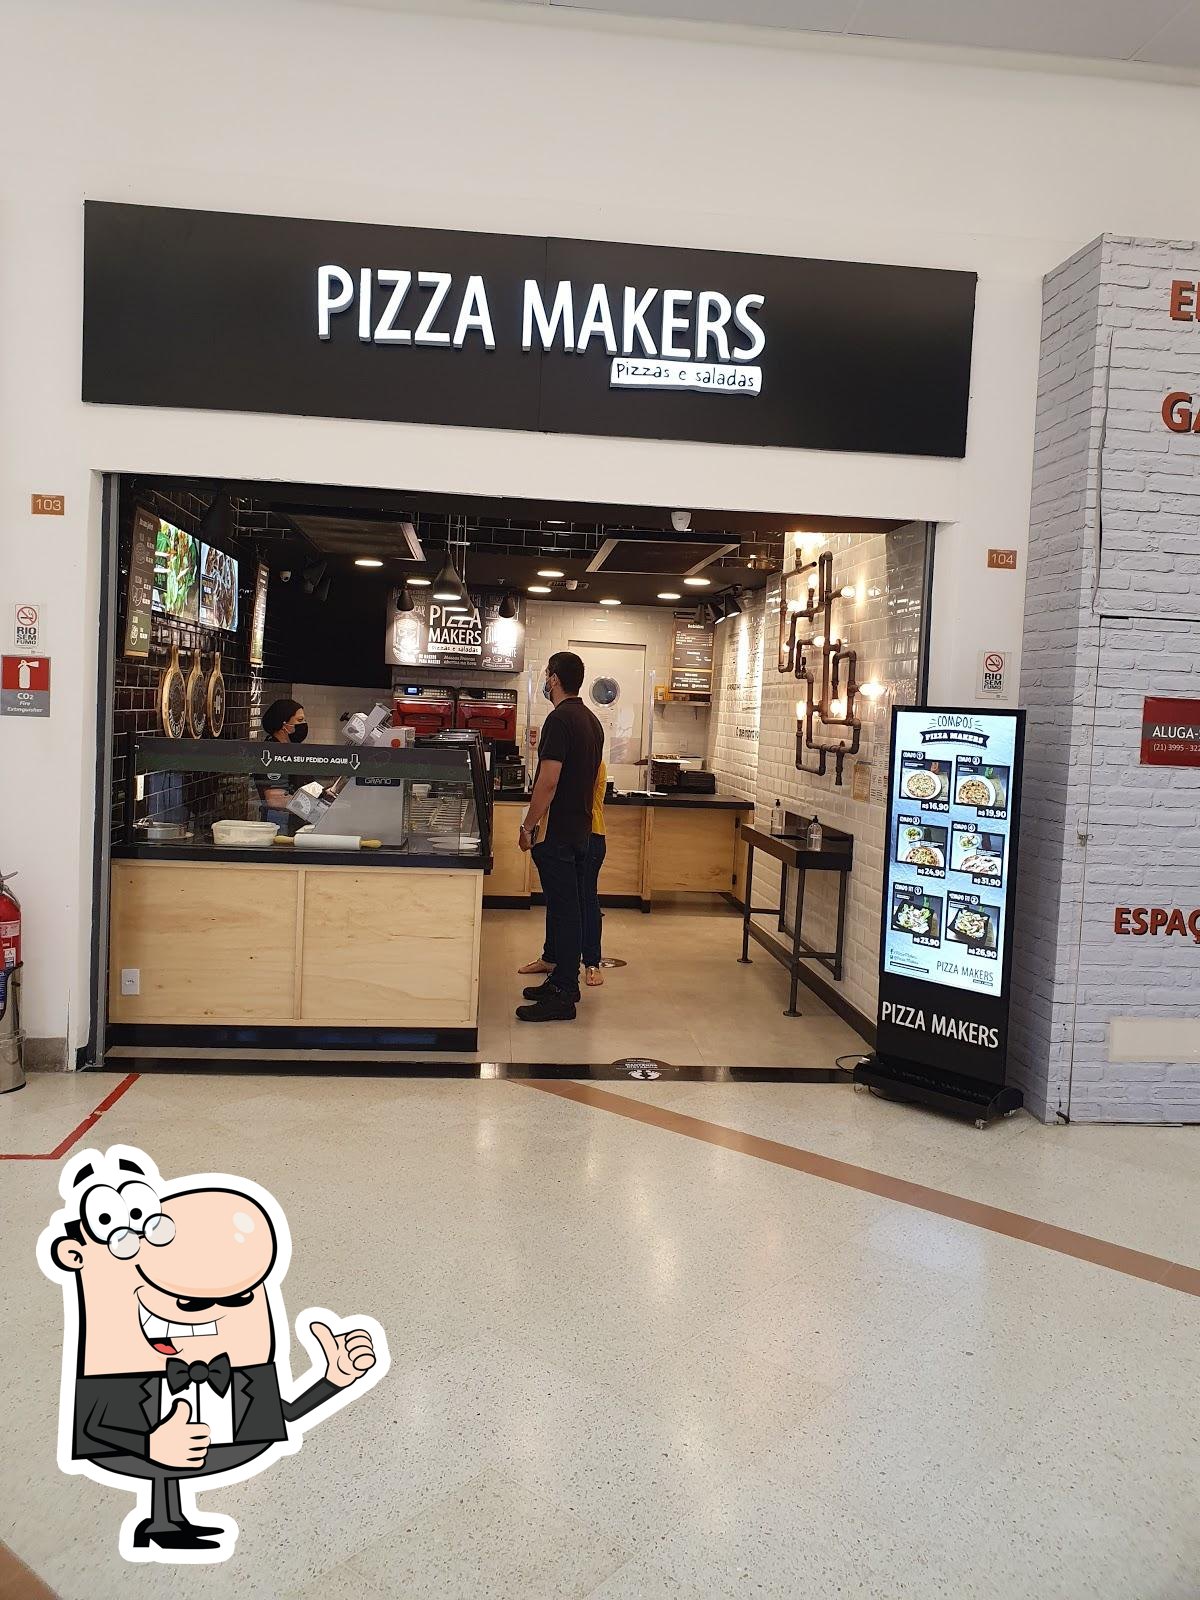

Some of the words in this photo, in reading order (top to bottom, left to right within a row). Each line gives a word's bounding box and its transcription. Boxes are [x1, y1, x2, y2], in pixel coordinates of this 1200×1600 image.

[1170, 280, 1200, 322] E
[318, 265, 496, 350] PIZZA
[521, 279, 766, 363] MAKERS
[678, 370, 686, 380] e
[695, 367, 754, 387] saladas
[36, 499, 61, 510] 103
[992, 553, 1014, 565] 104
[16, 626, 37, 635] RIO
[428, 627, 482, 645] MAKERS
[984, 672, 1002, 680] RIO
[937, 715, 974, 729] COMBOS
[924, 732, 948, 741] PIZZA
[949, 732, 984, 744] MAKERS
[1152, 725, 1200, 740] ALUGA-
[1153, 743, 1167, 752] (21)
[274, 755, 292, 763] FAÇA
[293, 755, 305, 763] SEU
[306, 756, 329, 764] PEDIDO
[929, 802, 949, 812] 16,90
[976, 947, 997, 959] 26,90
[936, 960, 959, 975] PIZZA
[961, 965, 994, 982] MAKERS
[881, 1001, 926, 1031] PIZZA
[931, 1013, 999, 1049] MAKERS
